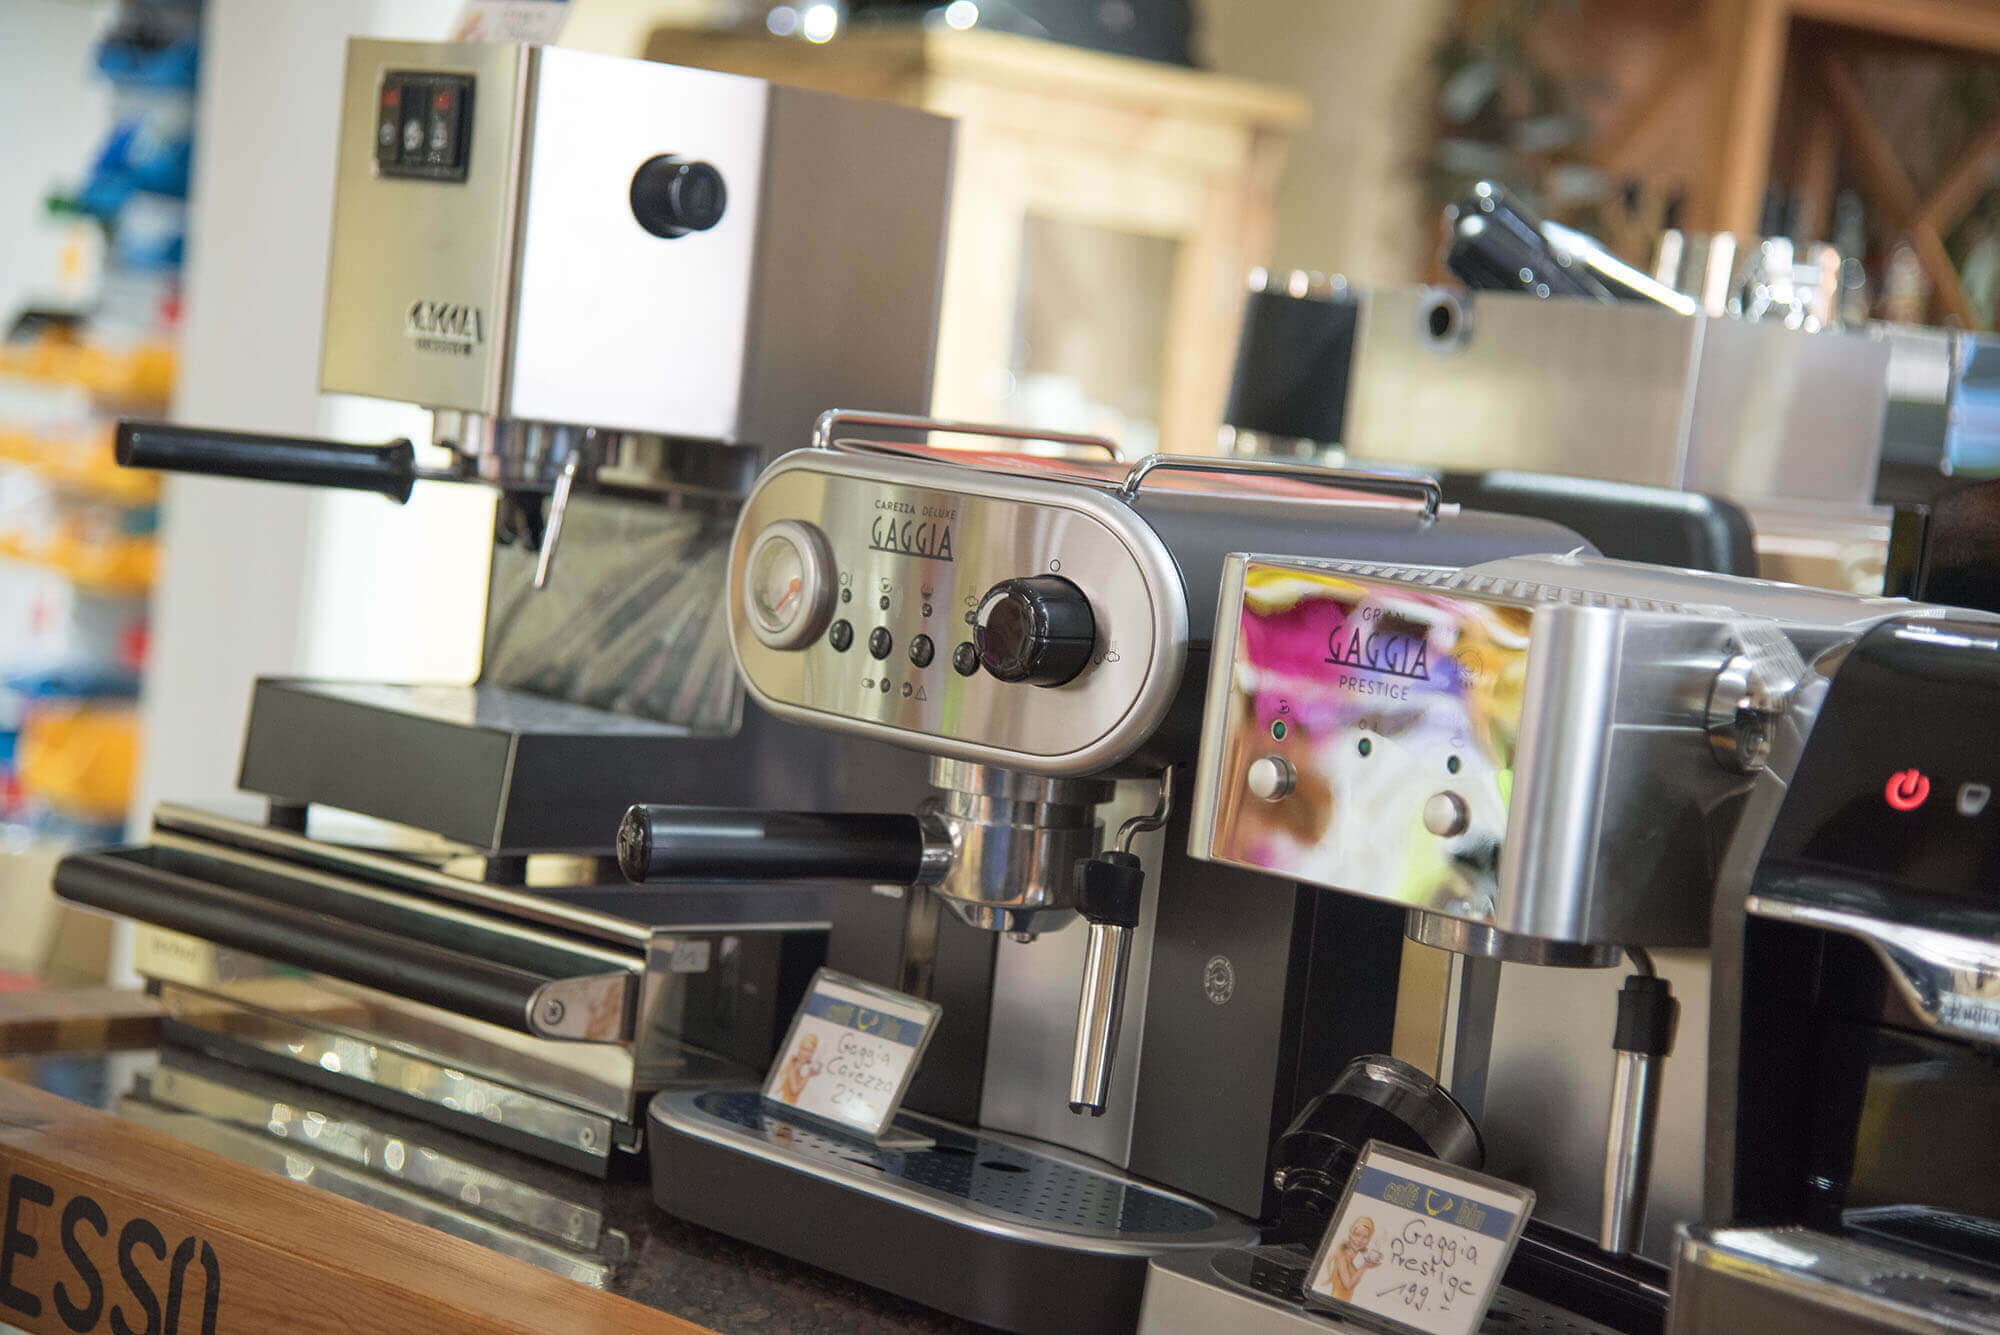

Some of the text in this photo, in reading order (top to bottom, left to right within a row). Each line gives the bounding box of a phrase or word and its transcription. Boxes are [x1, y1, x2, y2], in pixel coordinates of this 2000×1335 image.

[874, 499, 957, 520] CAREZZA DELUXE
[870, 515, 953, 561] GAGGIA
[1325, 626, 1430, 681] GAGGIA
[1339, 675, 1409, 701] PRESTIGE
[1403, 1219, 1477, 1268] Gaggia
[1391, 1238, 1476, 1303] Prestige
